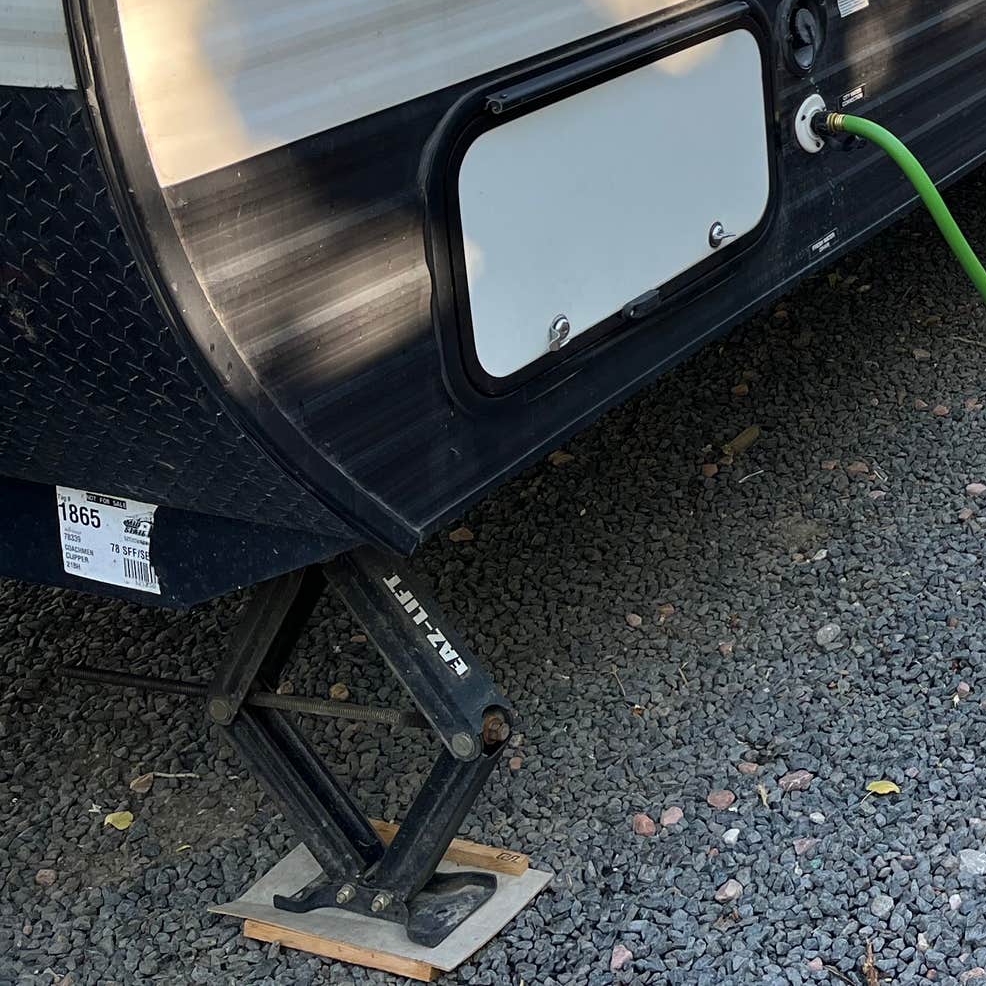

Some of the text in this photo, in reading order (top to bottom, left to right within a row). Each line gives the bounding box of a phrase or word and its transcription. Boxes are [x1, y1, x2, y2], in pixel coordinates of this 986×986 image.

[99, 496, 111, 505] FOR
[58, 502, 101, 529] 1865
[64, 544, 94, 556] COACHMEN
[110, 542, 120, 554] 78
[65, 552, 89, 564] CLIPPER
[382, 574, 468, 676] EAZ-LIFT
